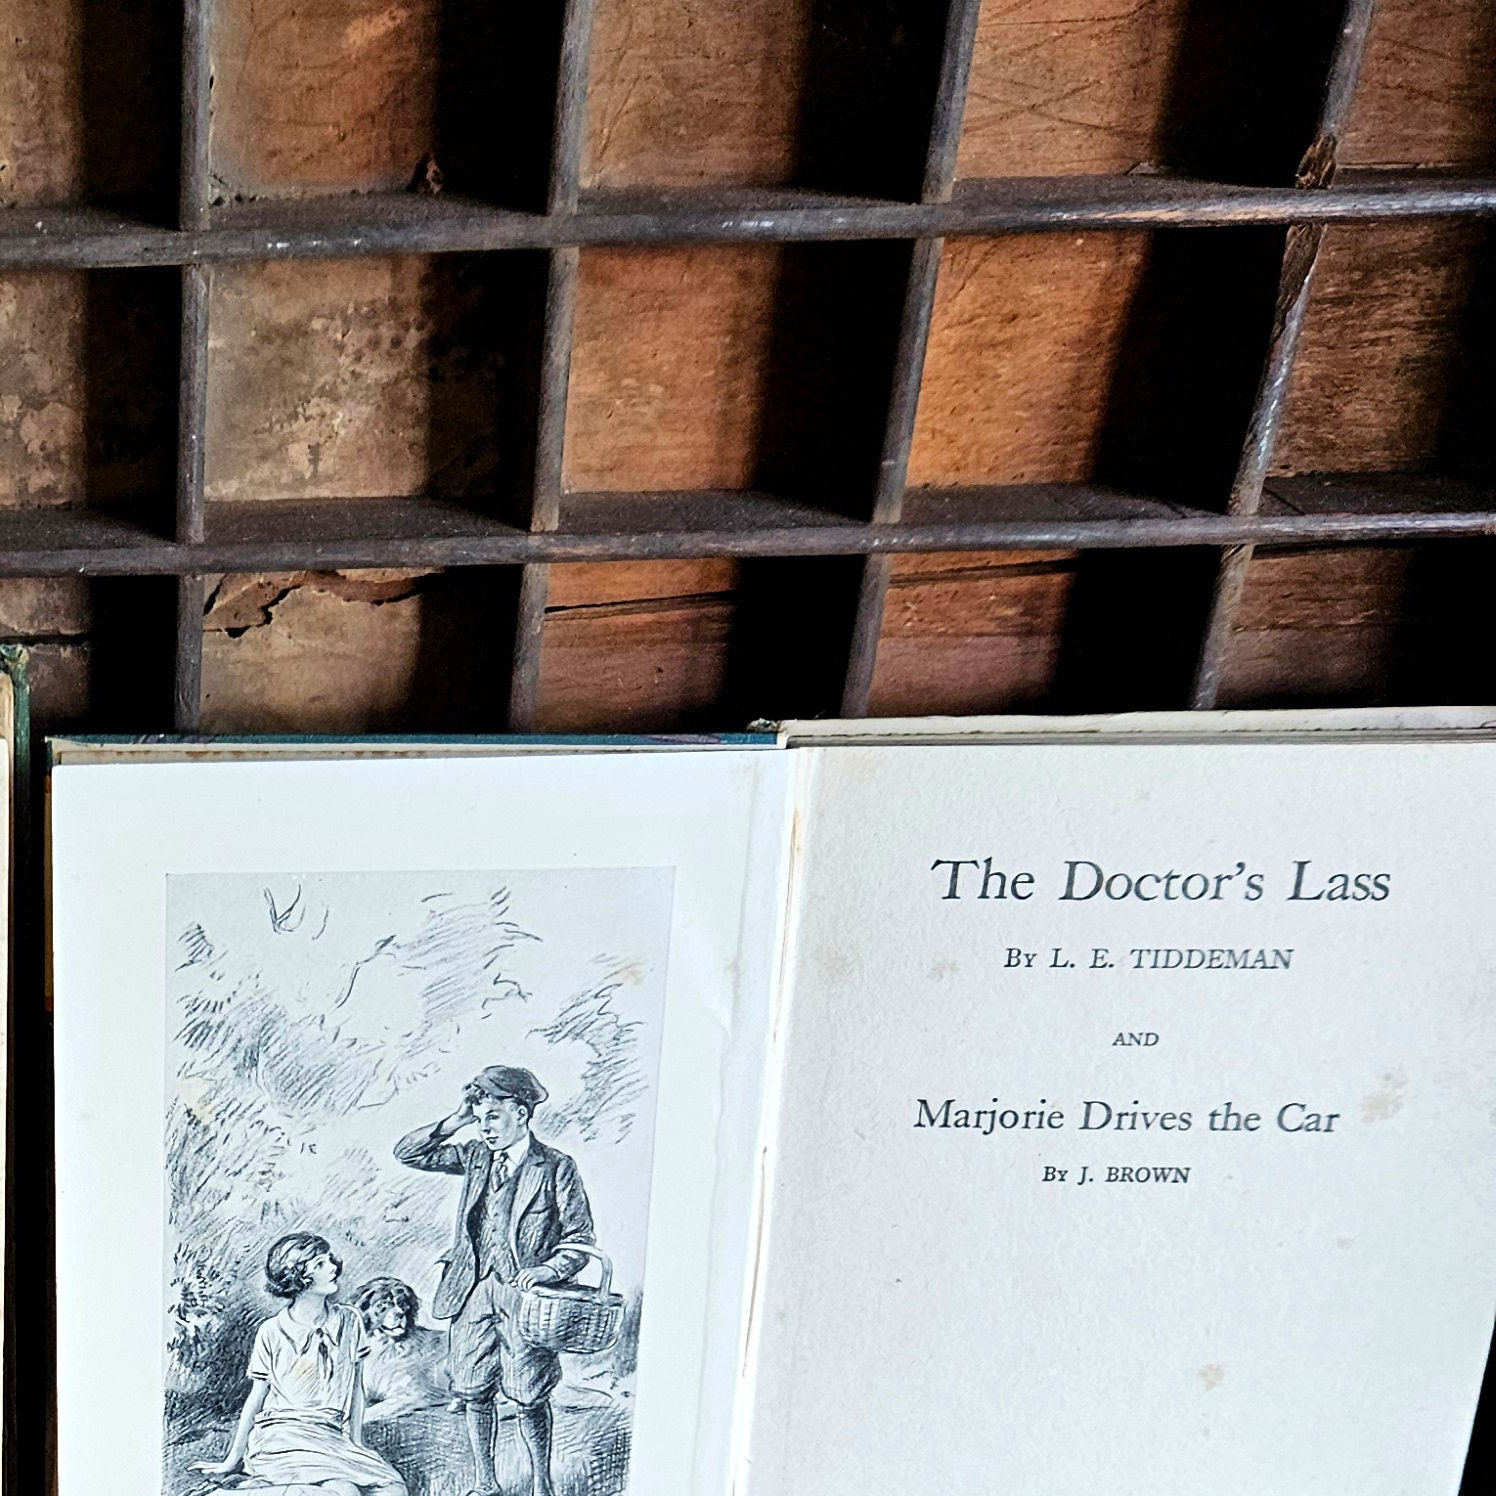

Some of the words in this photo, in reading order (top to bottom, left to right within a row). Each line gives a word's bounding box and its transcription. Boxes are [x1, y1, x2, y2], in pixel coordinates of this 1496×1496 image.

[931, 857, 1034, 900] The
[1058, 861, 1263, 901] Doctor's
[1287, 861, 1390, 901] Lass
[1004, 948, 1037, 967] By
[1050, 948, 1075, 968] L.
[1089, 949, 1114, 968] E.
[1130, 949, 1294, 969] TIDDEMAN
[1112, 1033, 1159, 1046] AND
[914, 1098, 1064, 1135] Marjorie
[1079, 1100, 1192, 1131] Drives
[1209, 1102, 1261, 1131] the
[1277, 1103, 1340, 1132] Car
[1042, 1166, 1068, 1181] By
[1077, 1167, 1093, 1185] J.
[1105, 1167, 1191, 1183] BROWN
